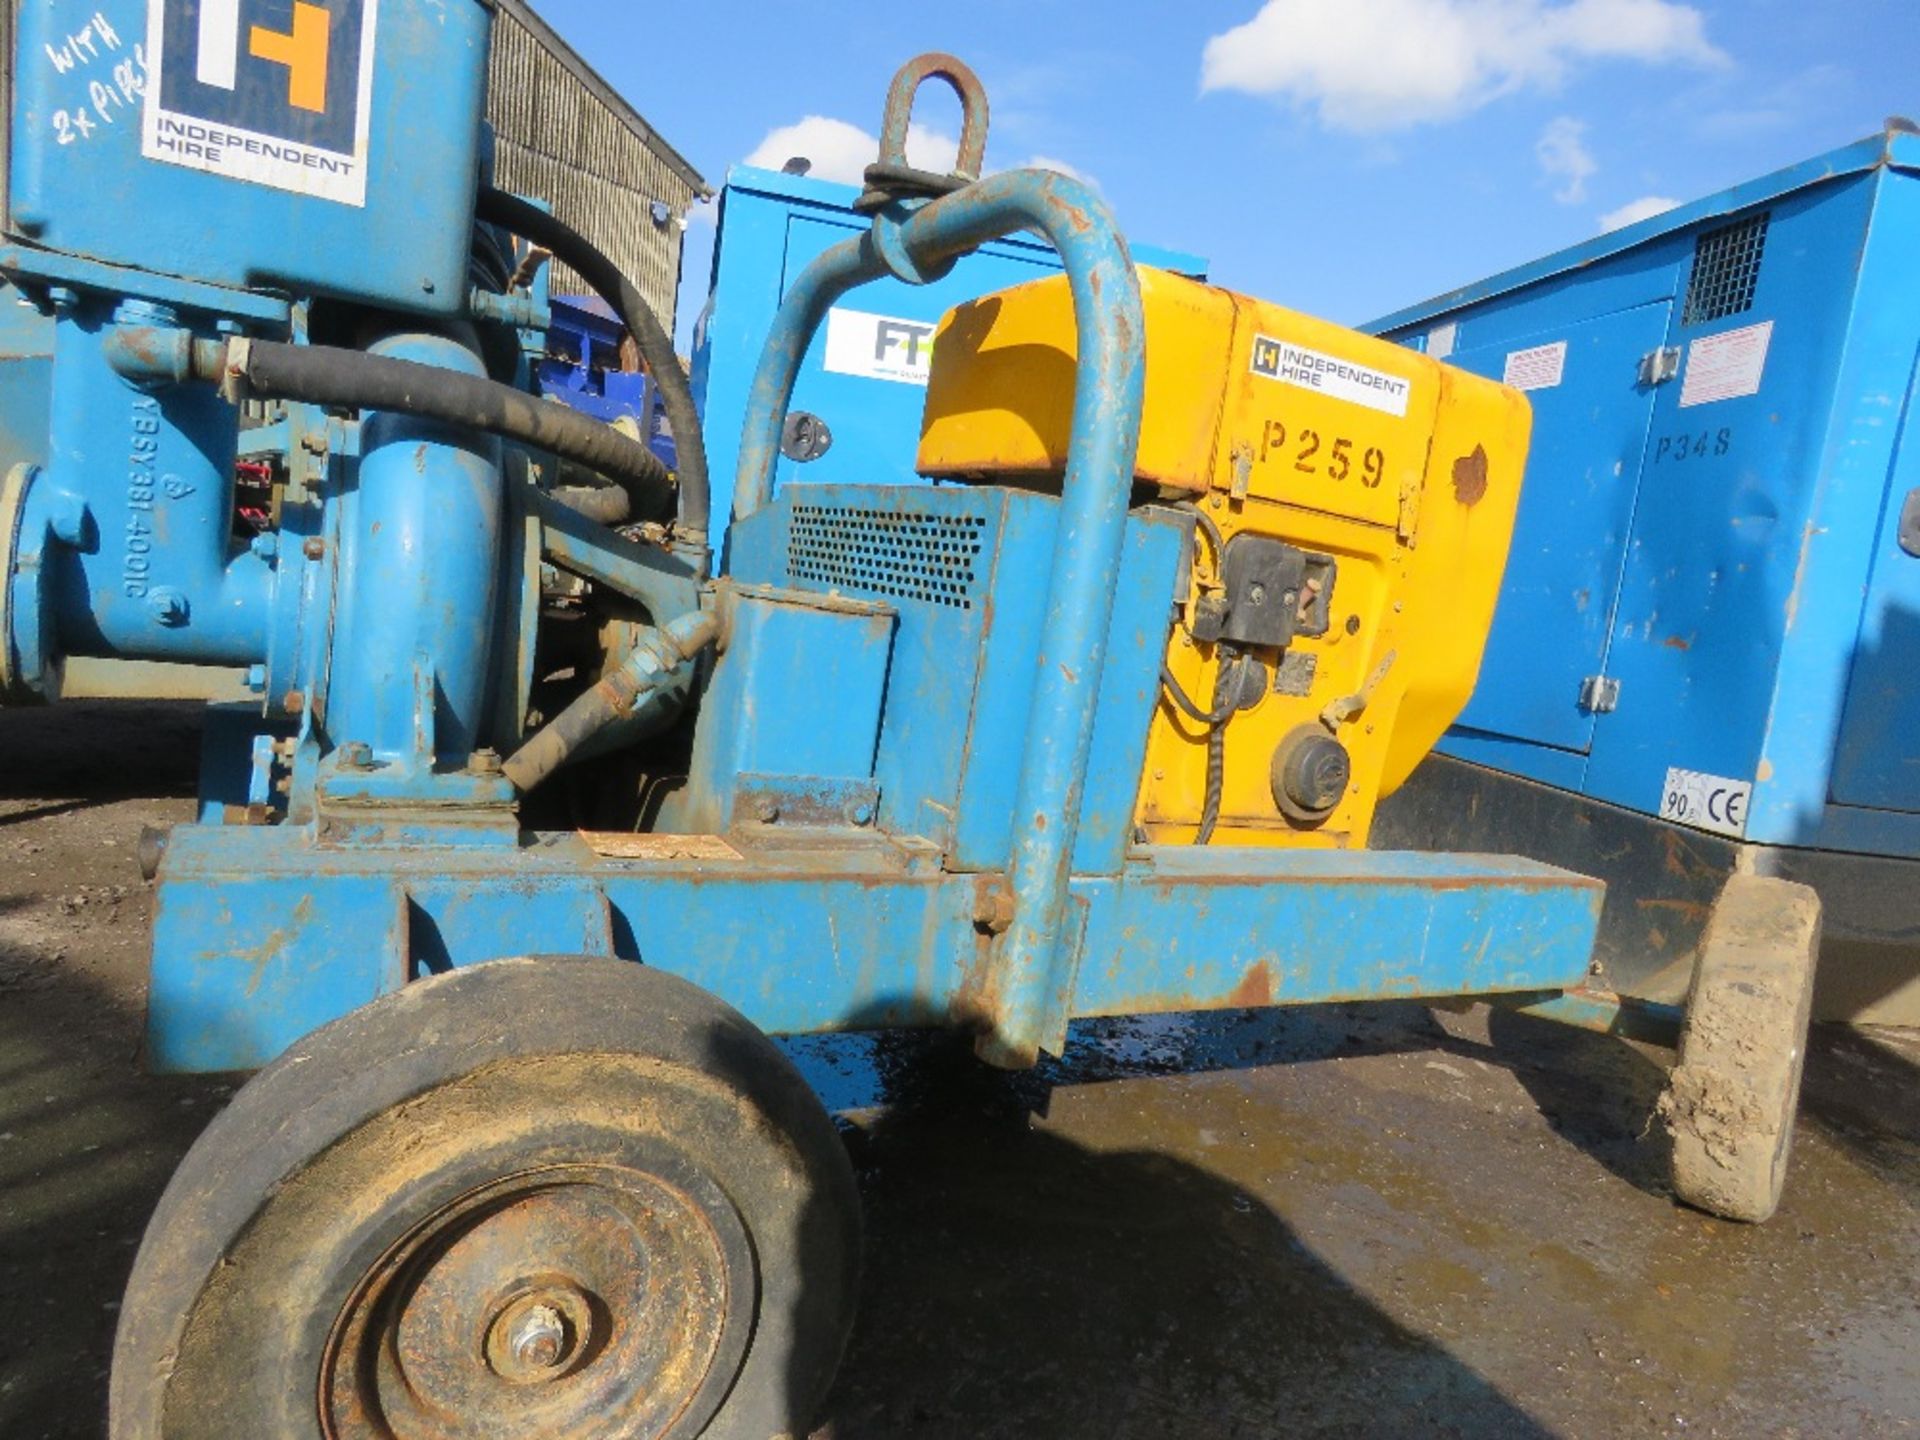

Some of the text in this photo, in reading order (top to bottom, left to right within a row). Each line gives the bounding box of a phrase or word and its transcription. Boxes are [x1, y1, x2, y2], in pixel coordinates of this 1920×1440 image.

[45, 12, 121, 74] WITH
[156, 117, 355, 176] INDEPENDENT
[156, 136, 222, 163] HIRE
[1281, 364, 1322, 387] HIRE
[1282, 348, 1406, 397] INDEPENDENT
[1667, 791, 1688, 817] 90
[1708, 788, 1744, 826] CE
